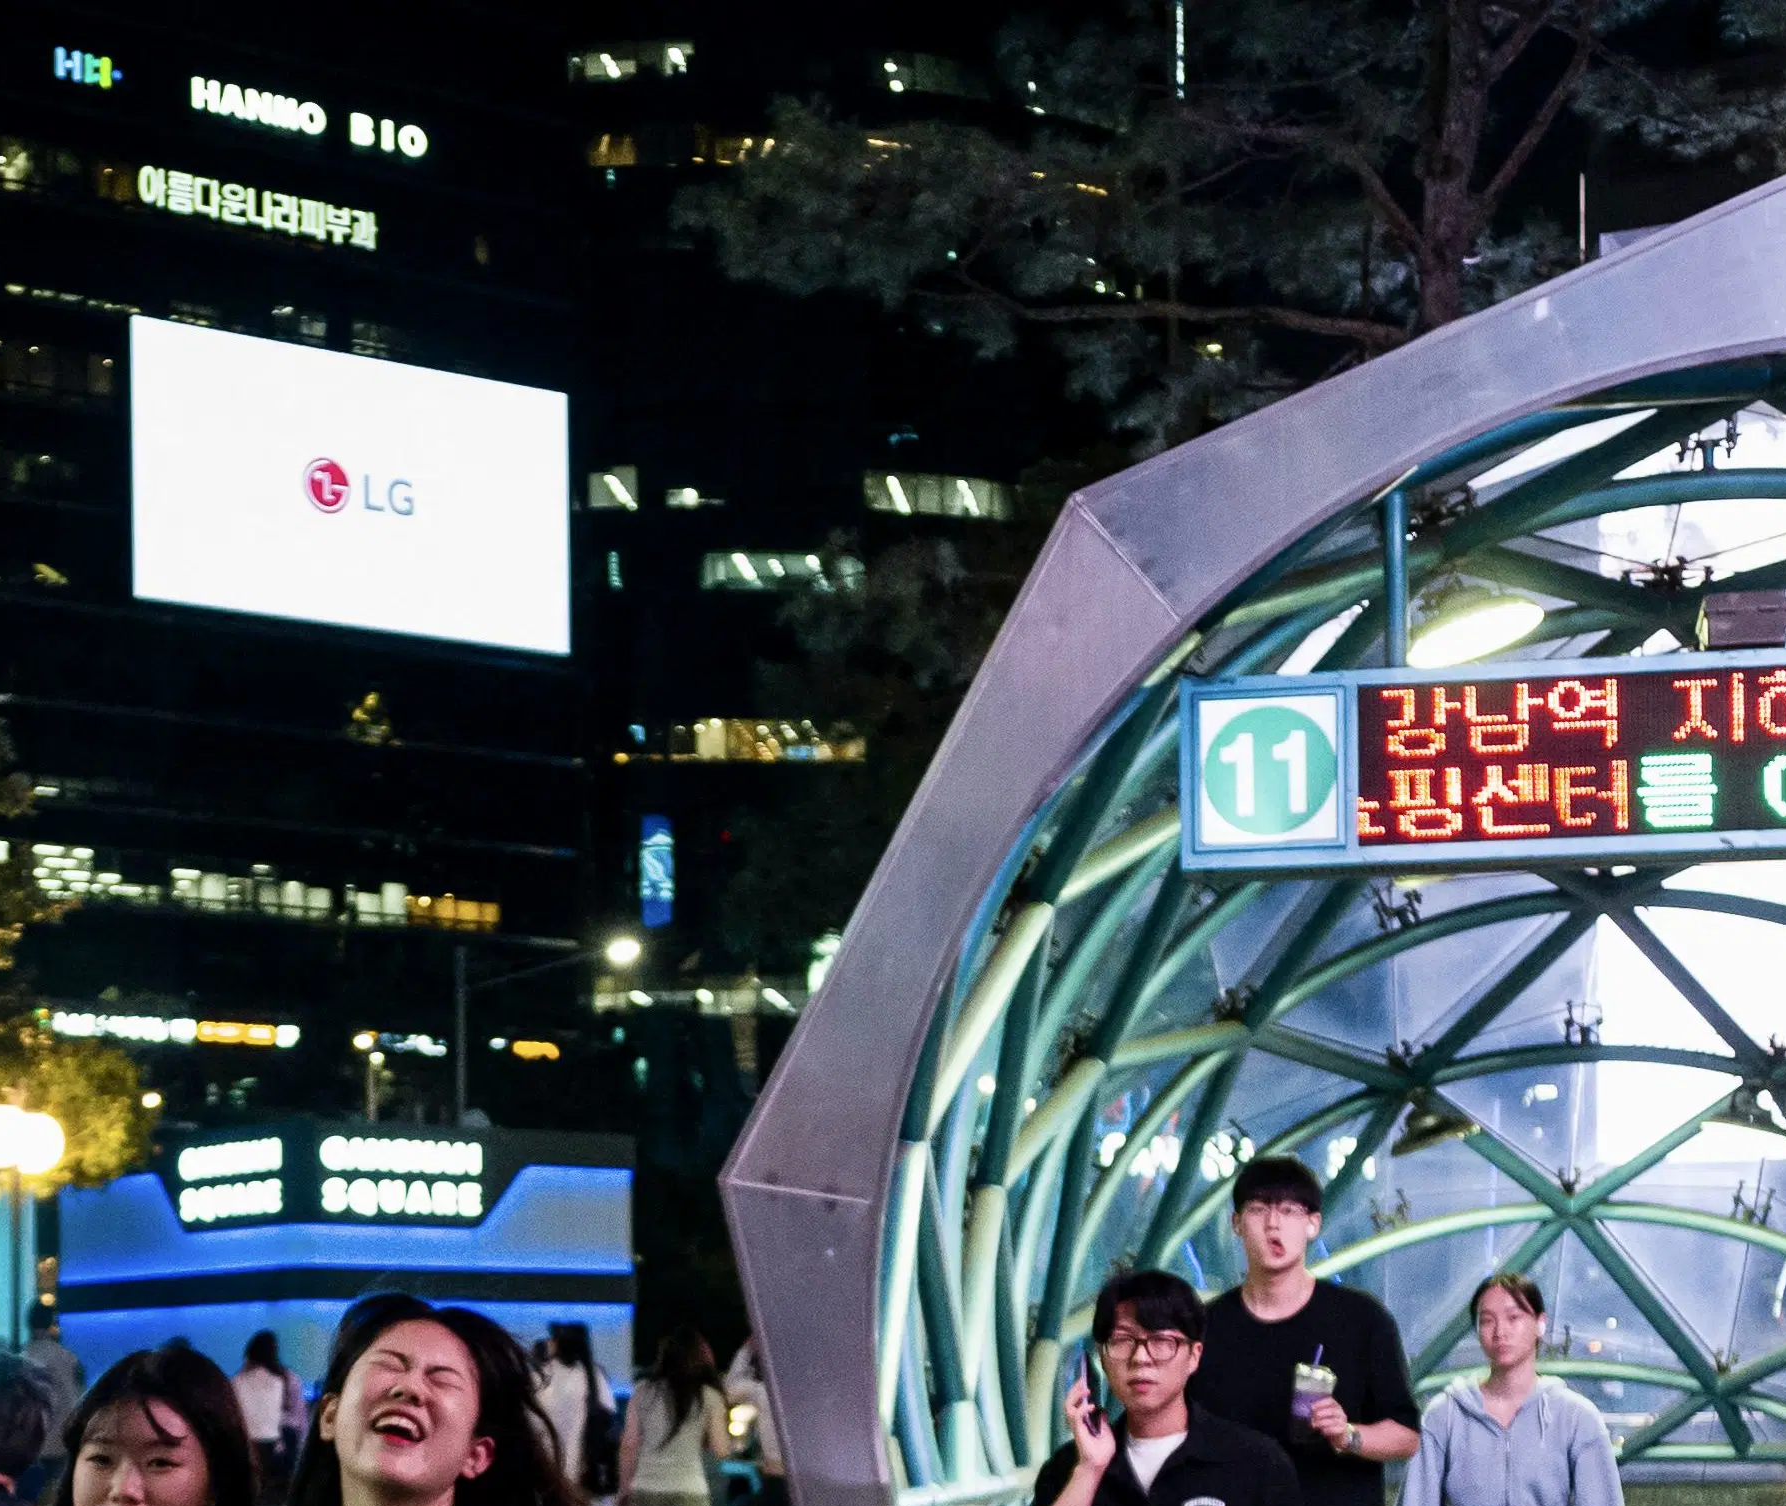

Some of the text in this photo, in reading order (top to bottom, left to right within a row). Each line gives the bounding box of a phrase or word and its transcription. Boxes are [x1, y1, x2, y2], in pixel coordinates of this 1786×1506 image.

[190, 75, 429, 158] HANMO BIO
[137, 164, 379, 252] 아름다운나라피부과
[363, 472, 415, 517] LG
[1379, 678, 1619, 758] 강남역
[1218, 729, 1310, 818] 11
[321, 1176, 484, 1217] SQUARE
